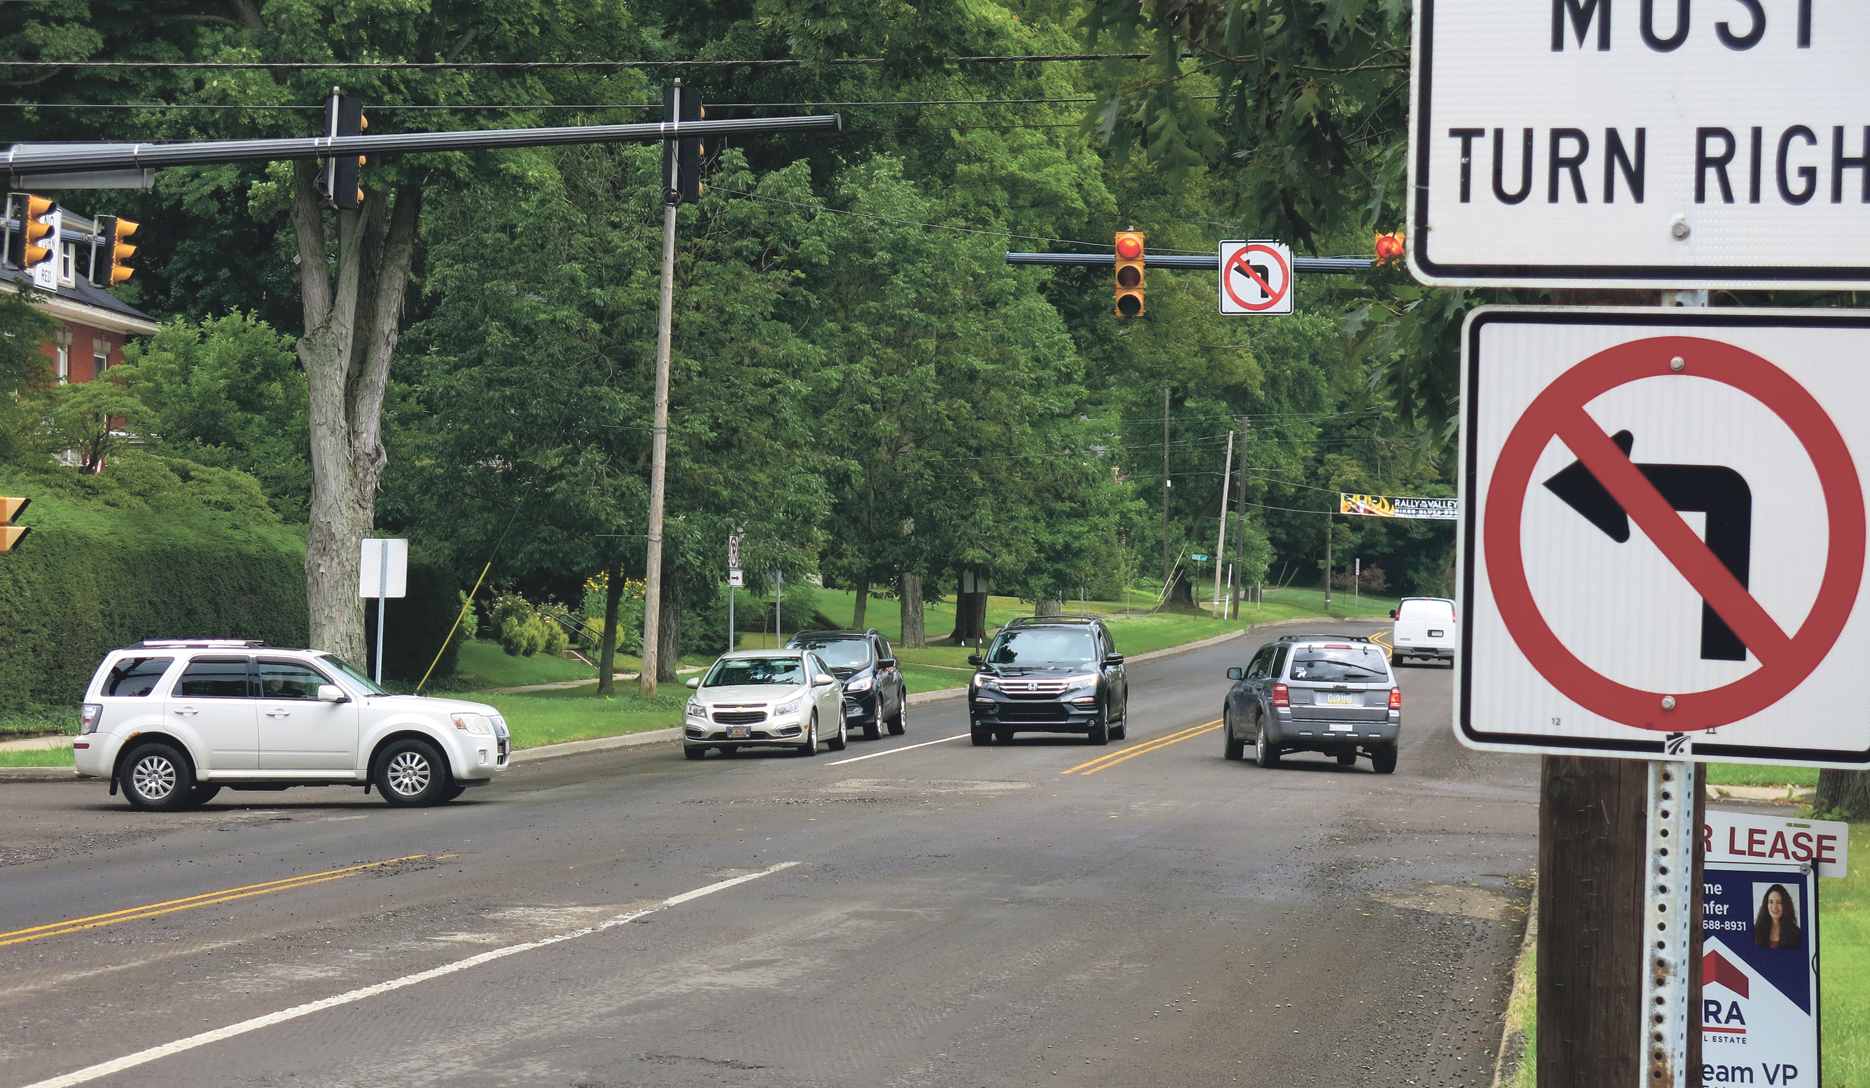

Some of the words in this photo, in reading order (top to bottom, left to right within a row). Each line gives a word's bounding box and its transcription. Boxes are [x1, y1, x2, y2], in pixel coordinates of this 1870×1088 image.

[1449, 127, 1646, 205] TURN
[1395, 499, 1420, 508] RALLY
[1427, 500, 1458, 509] VALLEY
[1551, 717, 1561, 726] 12
[1729, 826, 1837, 864] LEASE
[1702, 920, 1747, 931] 688-8931
[1704, 999, 1746, 1026] RA
[1712, 1035, 1747, 1045] ESTATE
[1702, 1063, 1754, 1084] eam
[1761, 1062, 1799, 1087] VP
